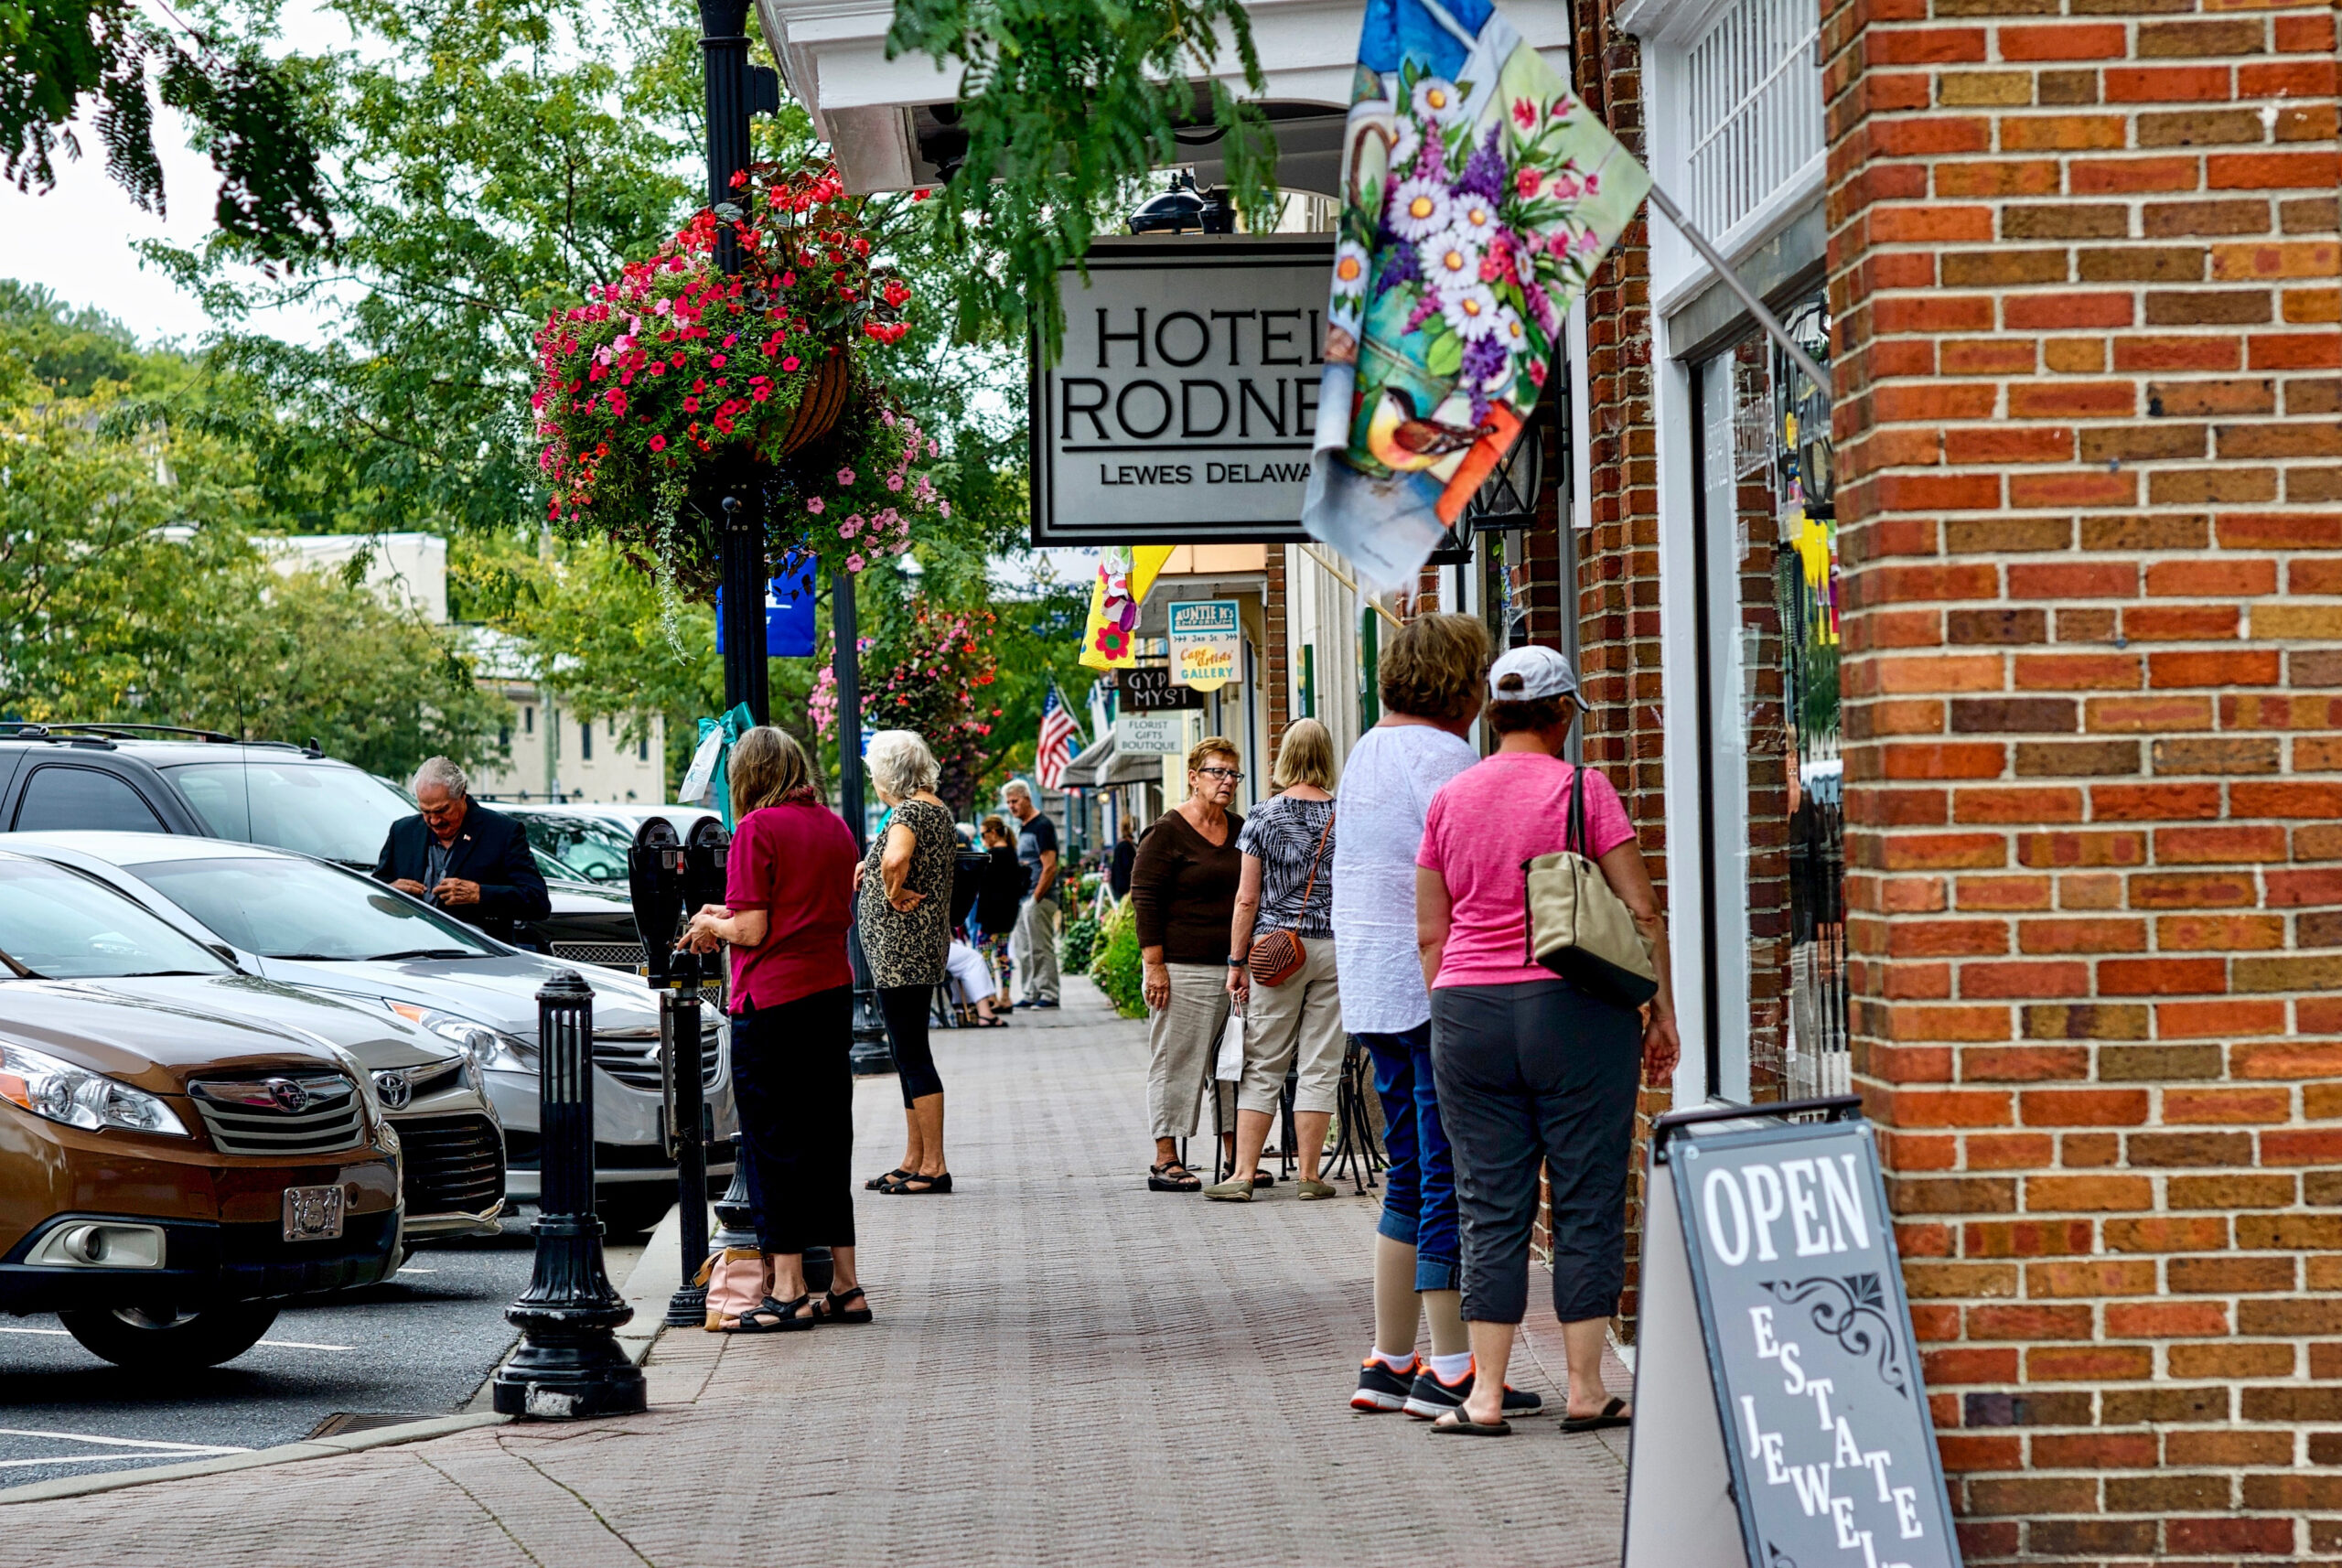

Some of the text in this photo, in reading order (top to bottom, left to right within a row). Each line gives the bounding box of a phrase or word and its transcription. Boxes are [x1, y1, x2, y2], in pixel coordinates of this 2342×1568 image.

[1096, 307, 1325, 368] HOTEL
[1060, 378, 1322, 440] RODNE
[1101, 461, 1312, 486] LEWES DELAWA
[1175, 606, 1217, 621] AUNTIE
[1176, 618, 1233, 627] EMPORIUM
[1180, 648, 1207, 661] Cape
[1128, 671, 1166, 689] GYP
[1180, 667, 1234, 680] GALLERY
[1128, 720, 1168, 729] FLORIST
[1134, 731, 1163, 740] GIFTS
[1122, 741, 1176, 750] BOUTIQUE
[1703, 1154, 1871, 1267] OPEN
[1748, 1305, 1923, 1540] ESTATE
[1740, 1395, 1913, 1568] JEWEL
